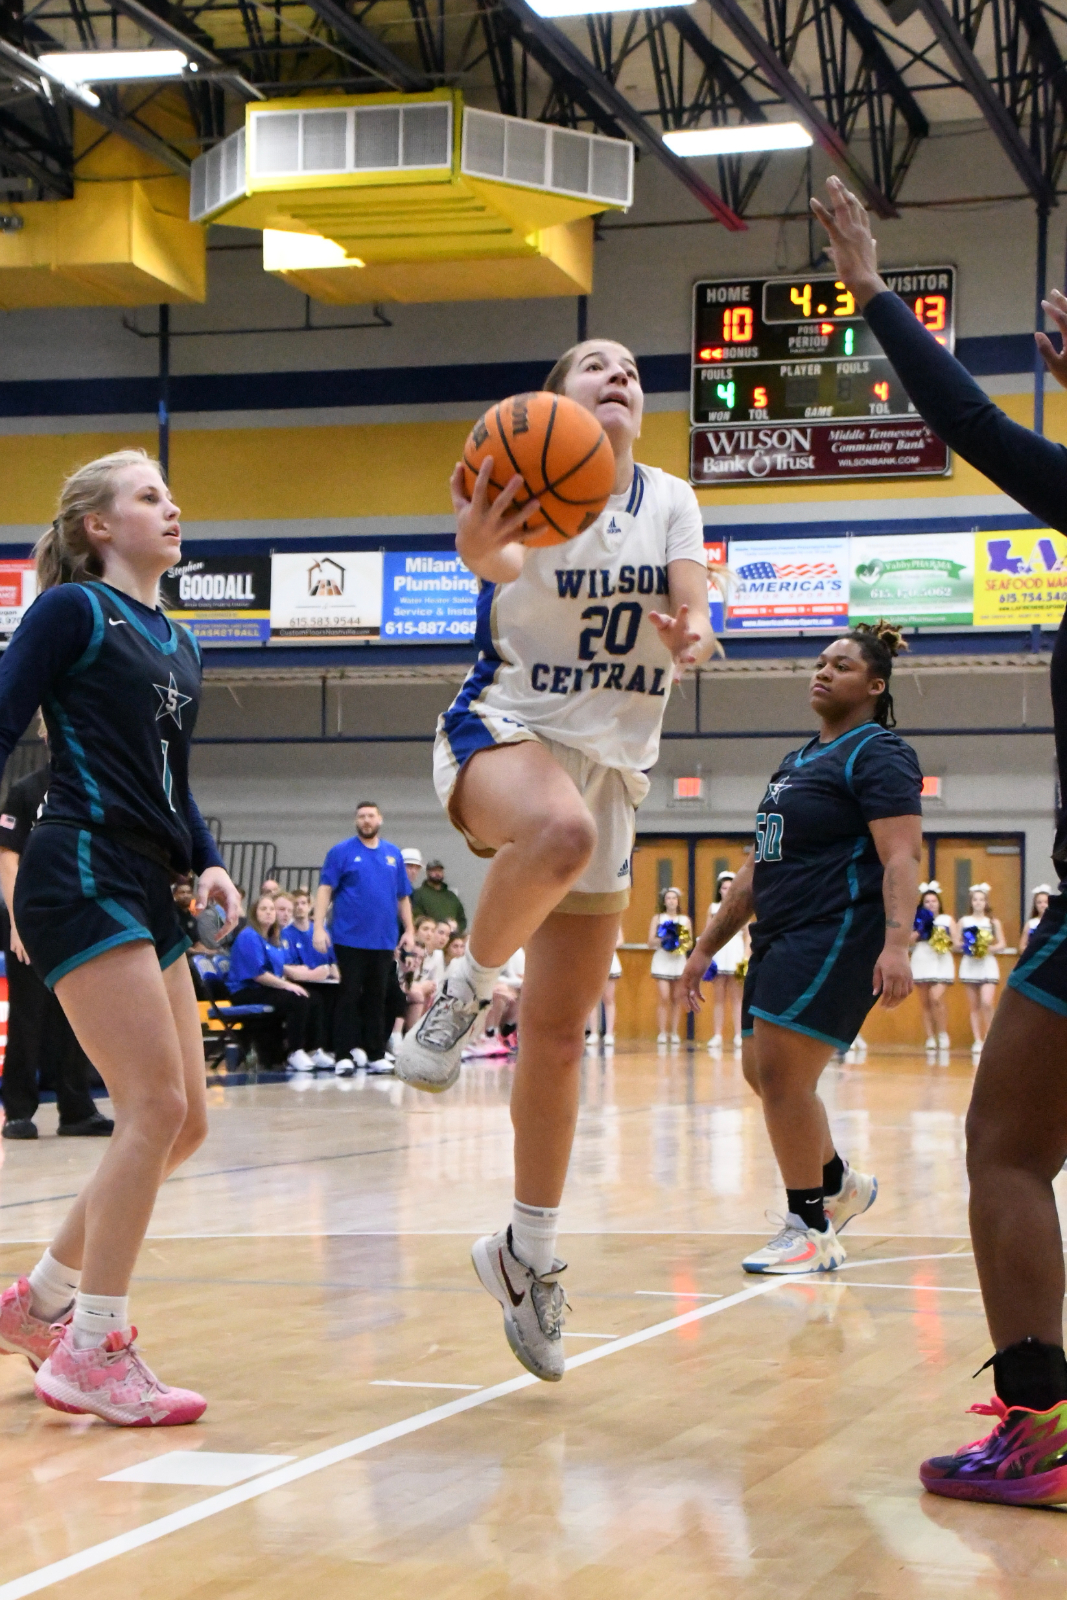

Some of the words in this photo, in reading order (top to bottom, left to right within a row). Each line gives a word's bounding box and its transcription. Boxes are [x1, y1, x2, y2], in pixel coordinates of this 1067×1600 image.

[886, 273, 949, 292] VISITOR
[706, 285, 751, 303] HOME
[914, 294, 946, 332] 13
[722, 306, 754, 342] 10
[788, 335, 829, 348] PERIOD
[722, 346, 760, 359] BONUS
[701, 368, 734, 380] FOULS
[780, 363, 823, 377] PLAYER
[836, 361, 871, 375] FOULS
[716, 380, 736, 409] 4
[752, 386, 769, 409] 5
[873, 381, 890, 402] 4
[708, 411, 732, 422] WON
[748, 408, 769, 420] TOL
[804, 405, 835, 418] GAME
[868, 402, 891, 415] TOL
[828, 429, 866, 440] Middle
[869, 425, 932, 440] Tennessee's
[706, 428, 813, 455] WILSON
[831, 441, 894, 454] Community
[896, 438, 926, 450] Bank
[702, 455, 747, 474] Bank
[771, 452, 816, 471] Trust
[167, 560, 206, 579] Stephen
[179, 573, 257, 601] GOODALL
[393, 575, 479, 595] Plumbing
[555, 565, 670, 599] WILSON
[736, 580, 842, 594] AMERICA'S
[985, 577, 1044, 591] SEAFOOD
[393, 607, 434, 617] Service
[436, 607, 445, 617] &
[289, 616, 362, 628] 615.583.9544
[193, 628, 260, 637] BASKETBALL
[577, 601, 643, 661] 20
